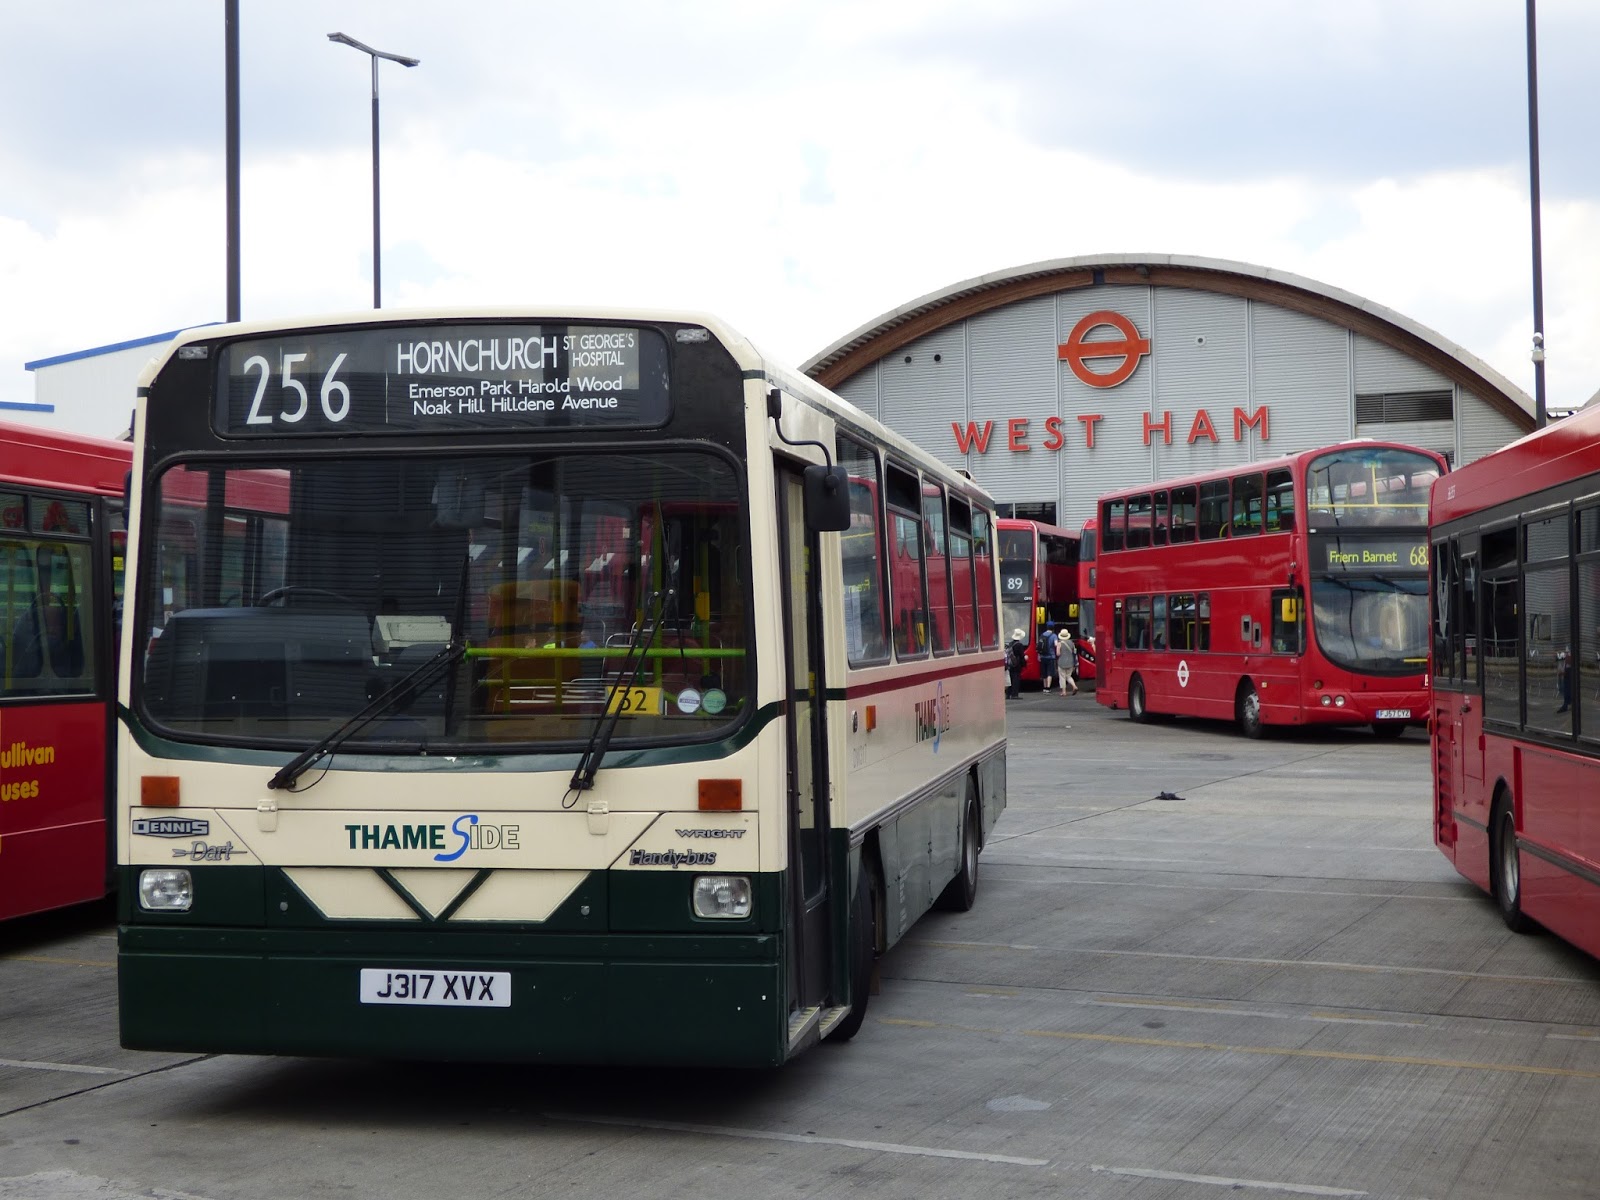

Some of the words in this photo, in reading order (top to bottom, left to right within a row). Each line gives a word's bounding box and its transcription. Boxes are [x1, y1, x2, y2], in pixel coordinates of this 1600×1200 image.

[563, 335, 576, 350] ST
[580, 333, 634, 350] GEORGE'S
[397, 336, 558, 375] HORNCHURCH
[572, 350, 625, 368] HOSPITAL
[243, 353, 350, 425] 256
[409, 383, 475, 399] Emerson
[480, 380, 512, 396] Park
[518, 377, 570, 394] Harold
[577, 375, 623, 392] Wood
[413, 399, 452, 416] Noak
[458, 397, 486, 414] Hill
[491, 396, 555, 412] Hilldene
[561, 394, 618, 410] Avenue
[951, 414, 1104, 454] WEST
[1143, 404, 1270, 446] HAM
[1329, 550, 1359, 563] Friern
[1362, 550, 1398, 563] Barnet
[1409, 546, 1429, 566] 68
[1007, 577, 1023, 590] 89
[1, 741, 55, 769] ullivan
[1, 779, 39, 801] uses
[132, 819, 209, 835] DENNIS
[675, 829, 747, 839] WRIGHT
[189, 840, 234, 861] Dart
[629, 848, 717, 869] Handy-bus
[376, 973, 435, 999] J317
[443, 975, 494, 1001] XVX
